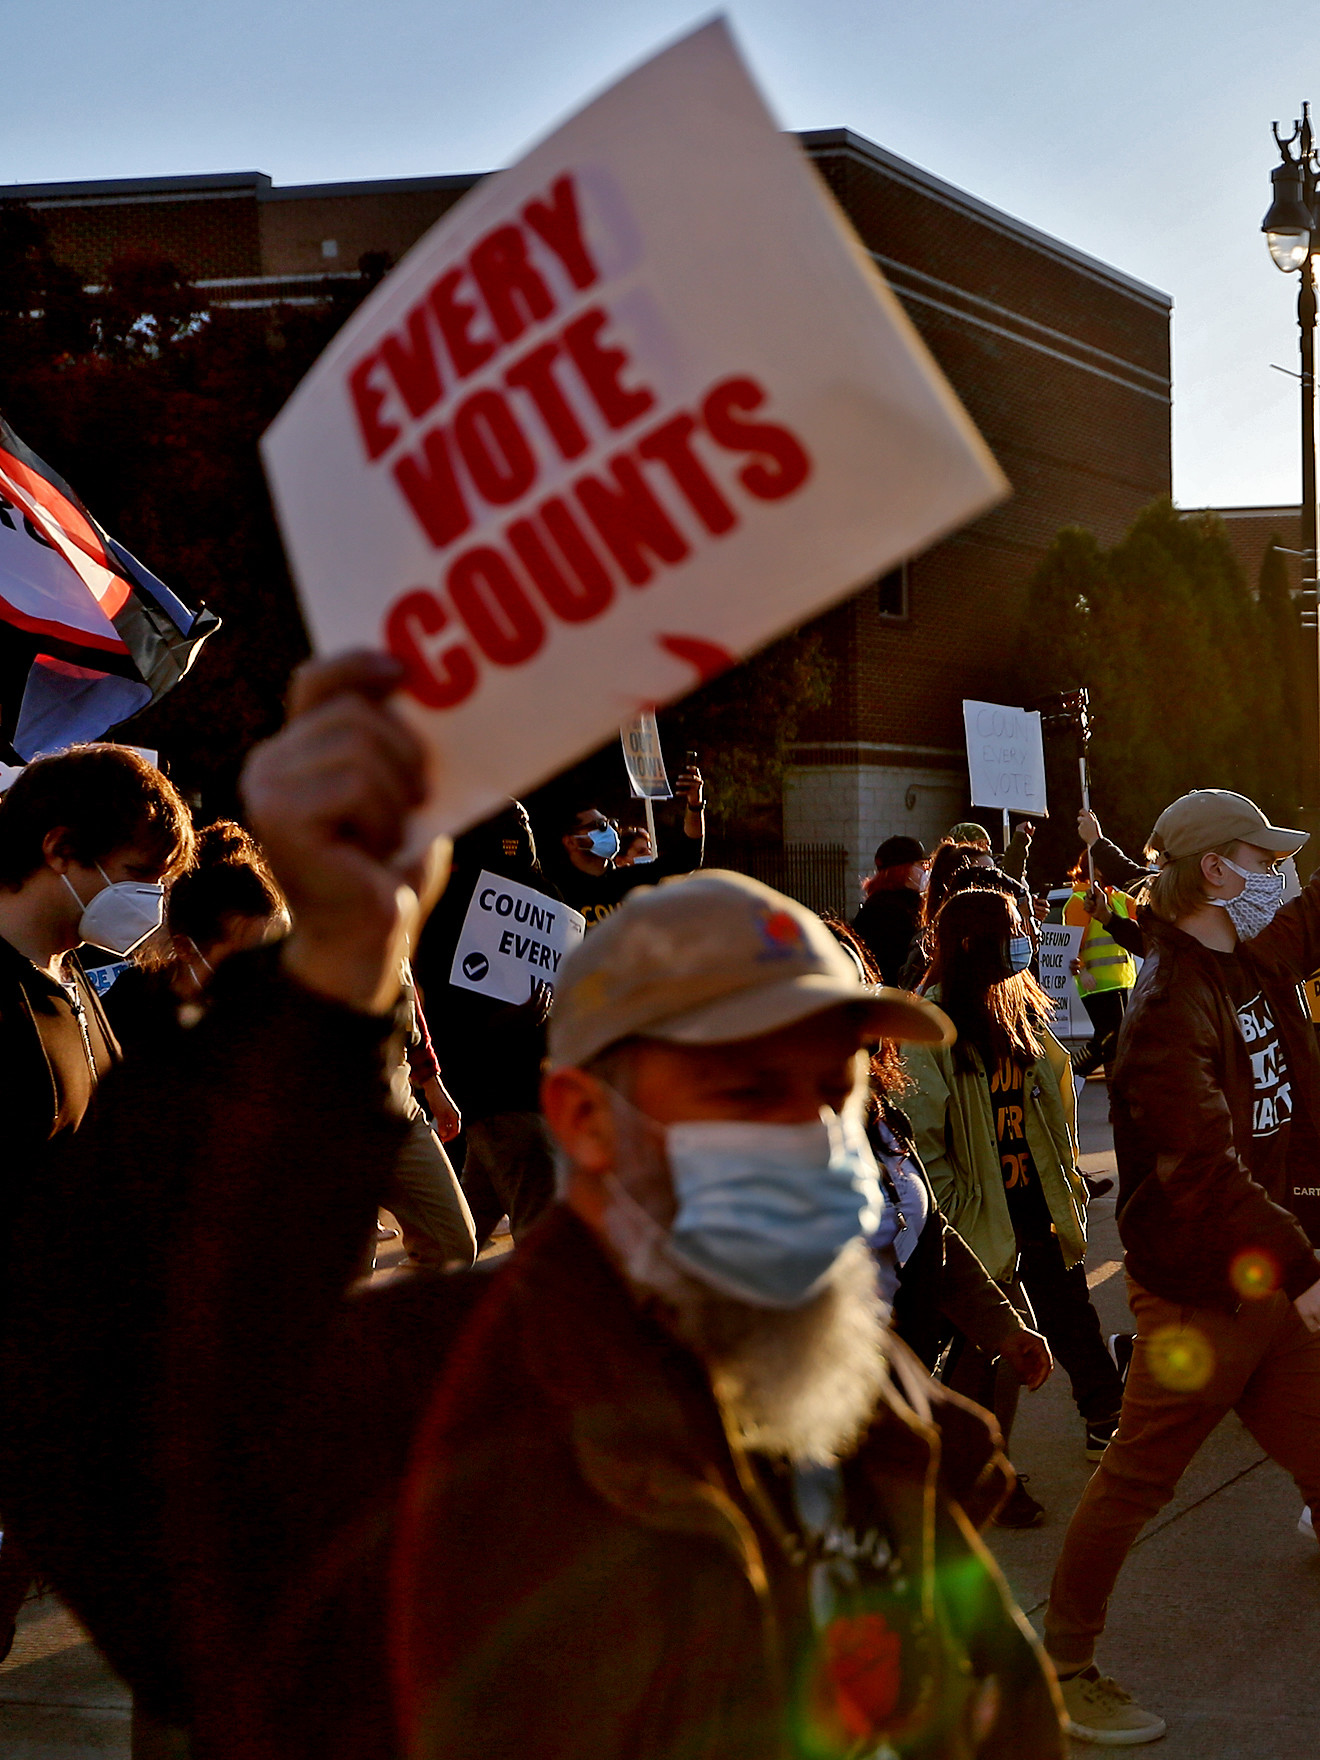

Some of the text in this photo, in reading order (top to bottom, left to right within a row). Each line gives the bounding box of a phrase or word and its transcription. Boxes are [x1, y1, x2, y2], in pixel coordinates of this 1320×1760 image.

[346, 171, 600, 465] EVERY
[391, 306, 657, 551] VOTE
[382, 374, 813, 711] COUNTS
[479, 889, 556, 935] COUNT
[498, 930, 563, 973] EVERY
